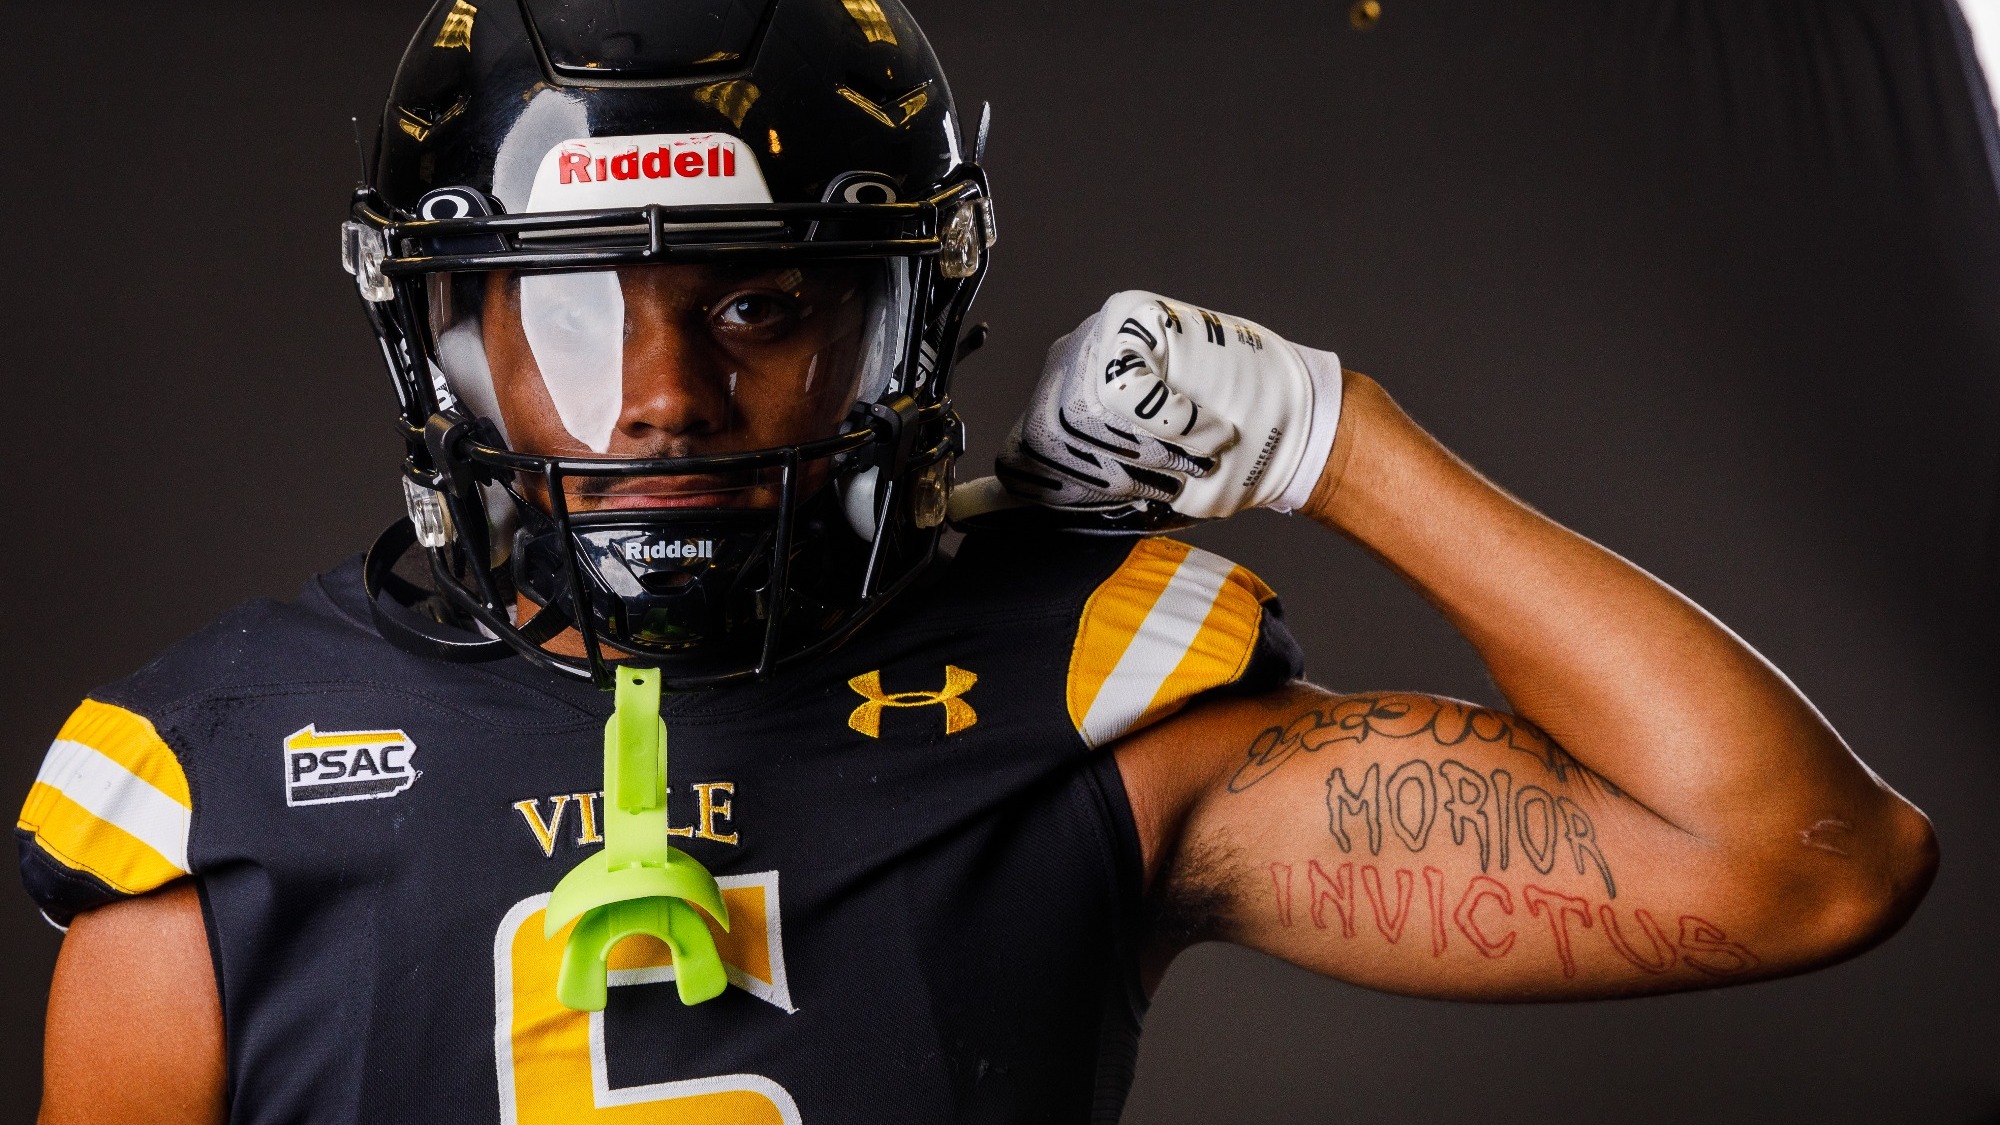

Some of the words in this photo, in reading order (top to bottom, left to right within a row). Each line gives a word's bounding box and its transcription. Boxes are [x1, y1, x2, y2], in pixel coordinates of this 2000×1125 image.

[558, 142, 735, 184] Riddell
[1242, 427, 1278, 487] ENGINEERED
[625, 540, 713, 560] Riddell
[291, 745, 405, 783] PSAC
[512, 782, 739, 857] VIE
[1326, 759, 1616, 899] MORIOR
[1269, 859, 1760, 979] INVICTUS
